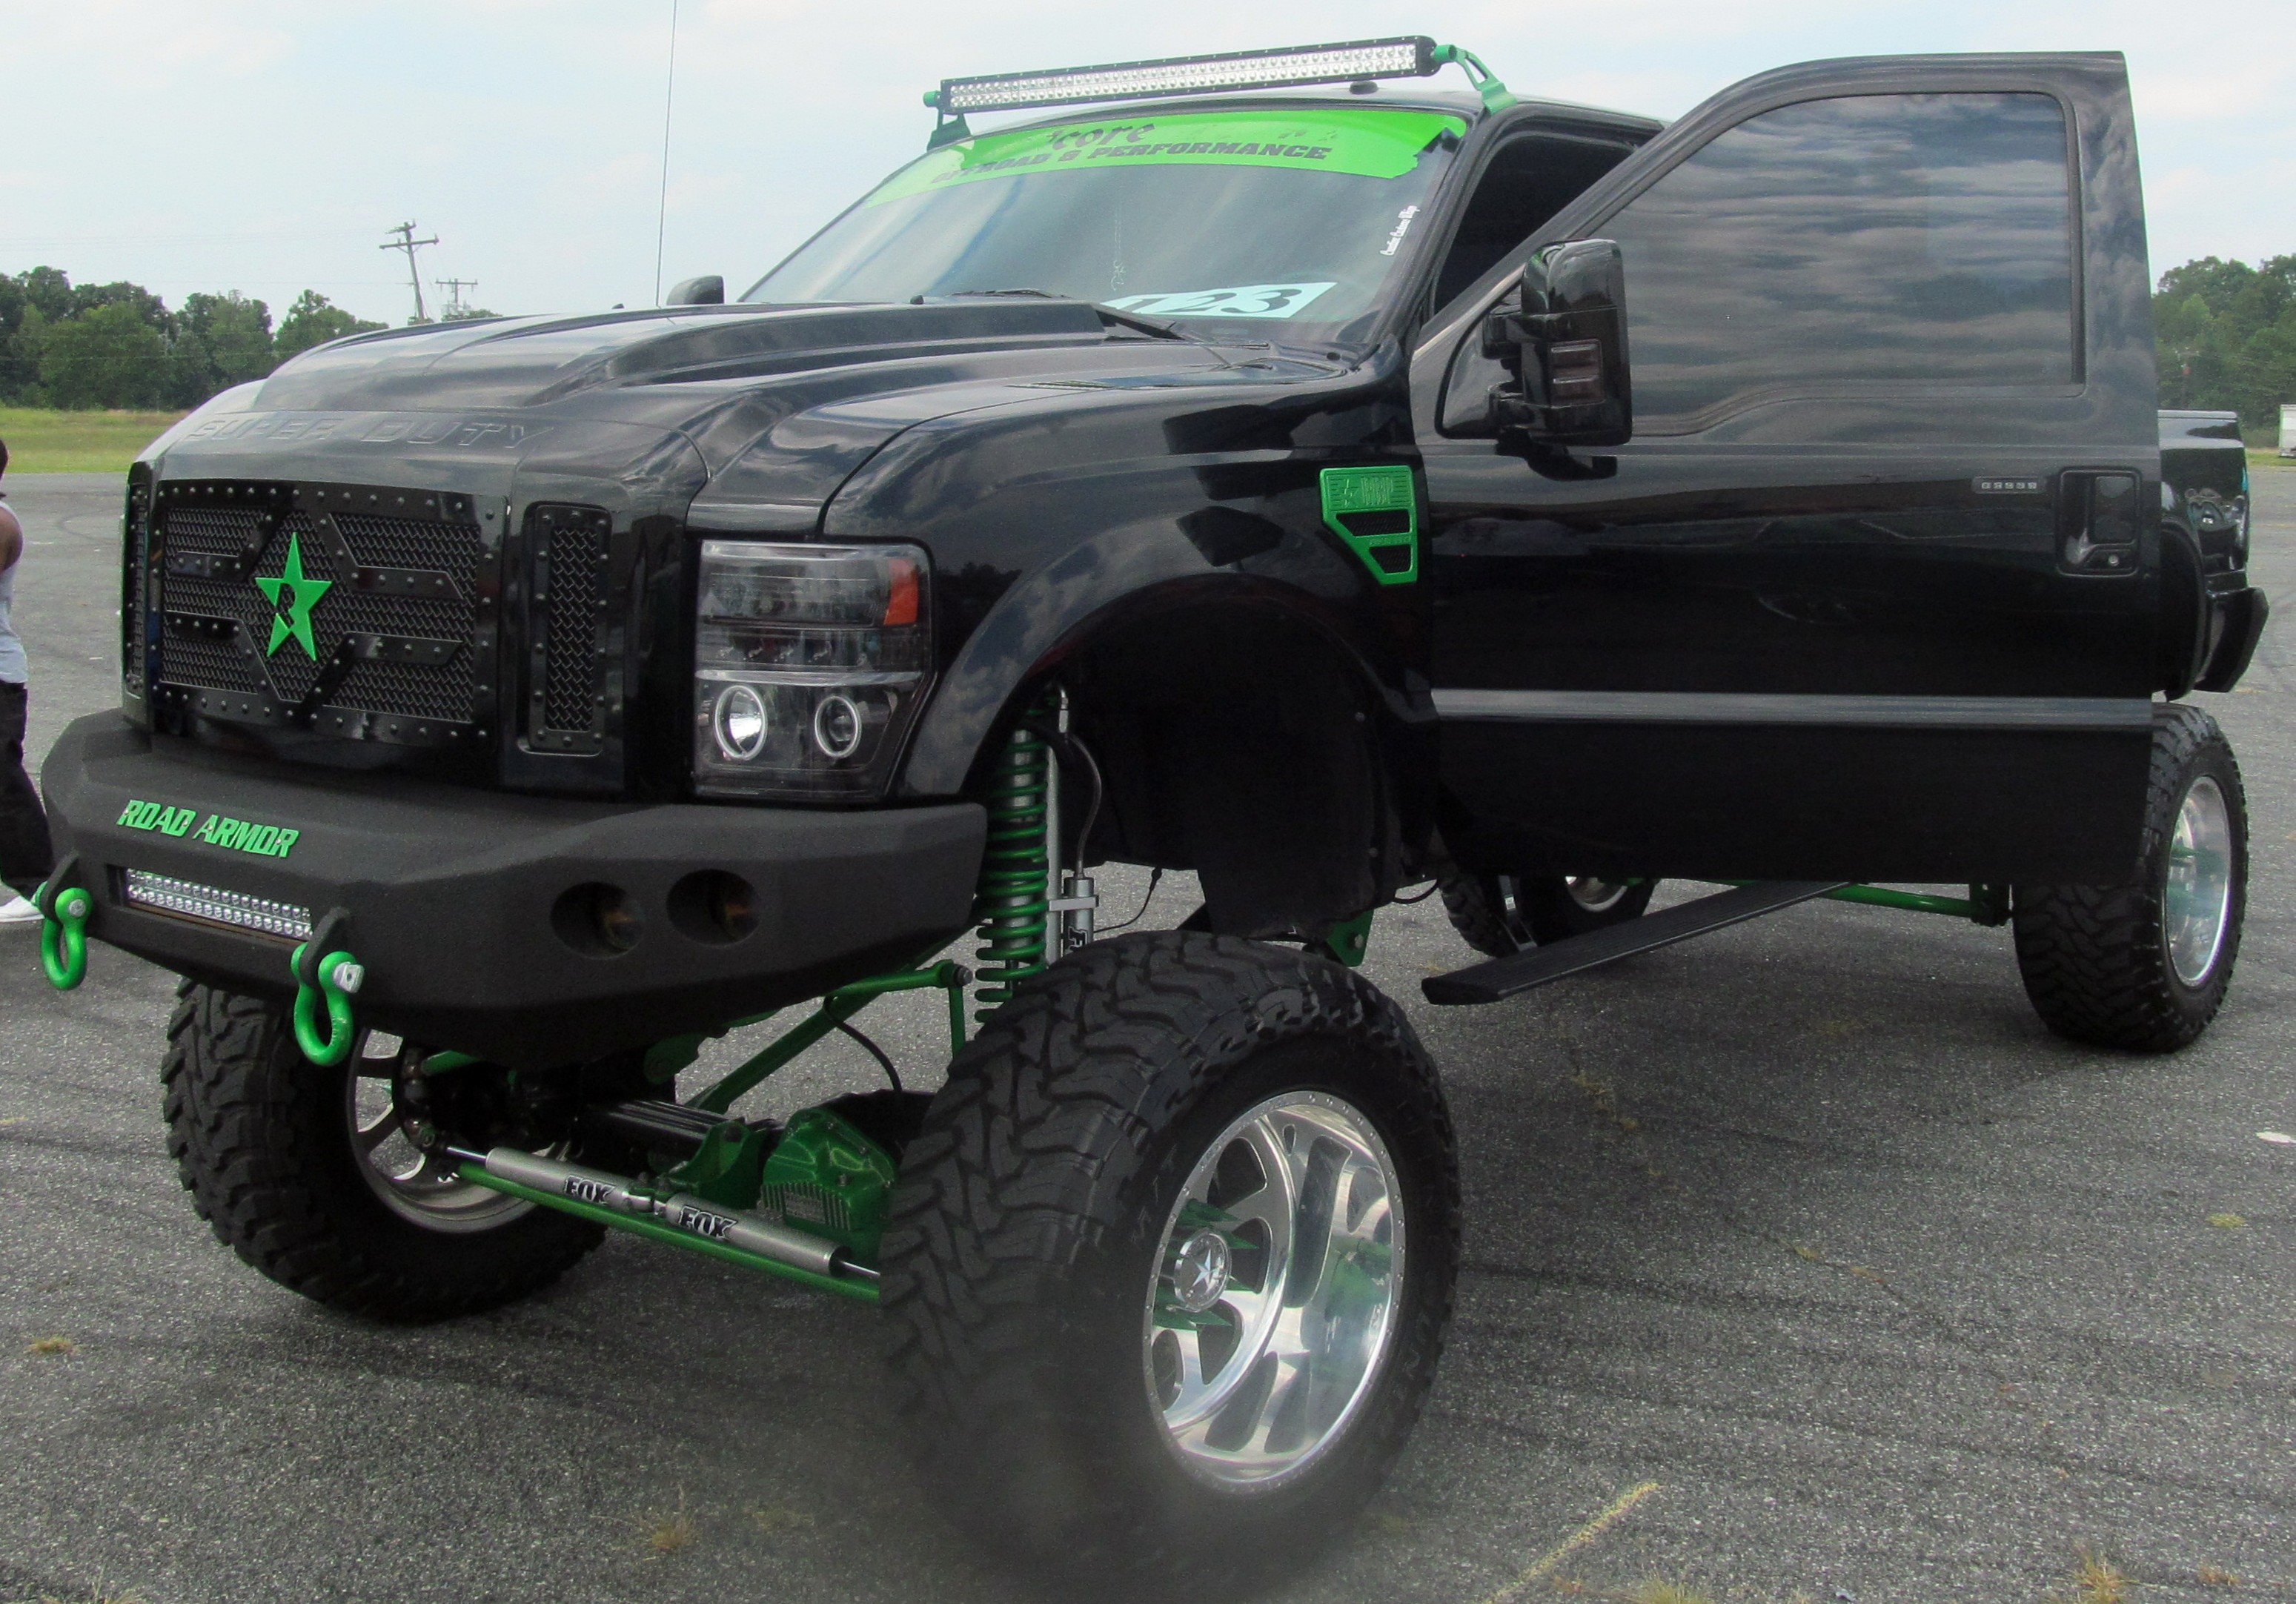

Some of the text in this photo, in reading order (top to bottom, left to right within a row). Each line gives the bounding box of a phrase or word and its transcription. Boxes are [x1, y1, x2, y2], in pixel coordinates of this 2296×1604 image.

[1087, 142, 1333, 159] PERFORMANCE
[183, 417, 554, 449] SUPER DUTY
[116, 799, 299, 858] ROAD ARMOR
[564, 1174, 616, 1205] FOX
[679, 1204, 737, 1240] FOX
